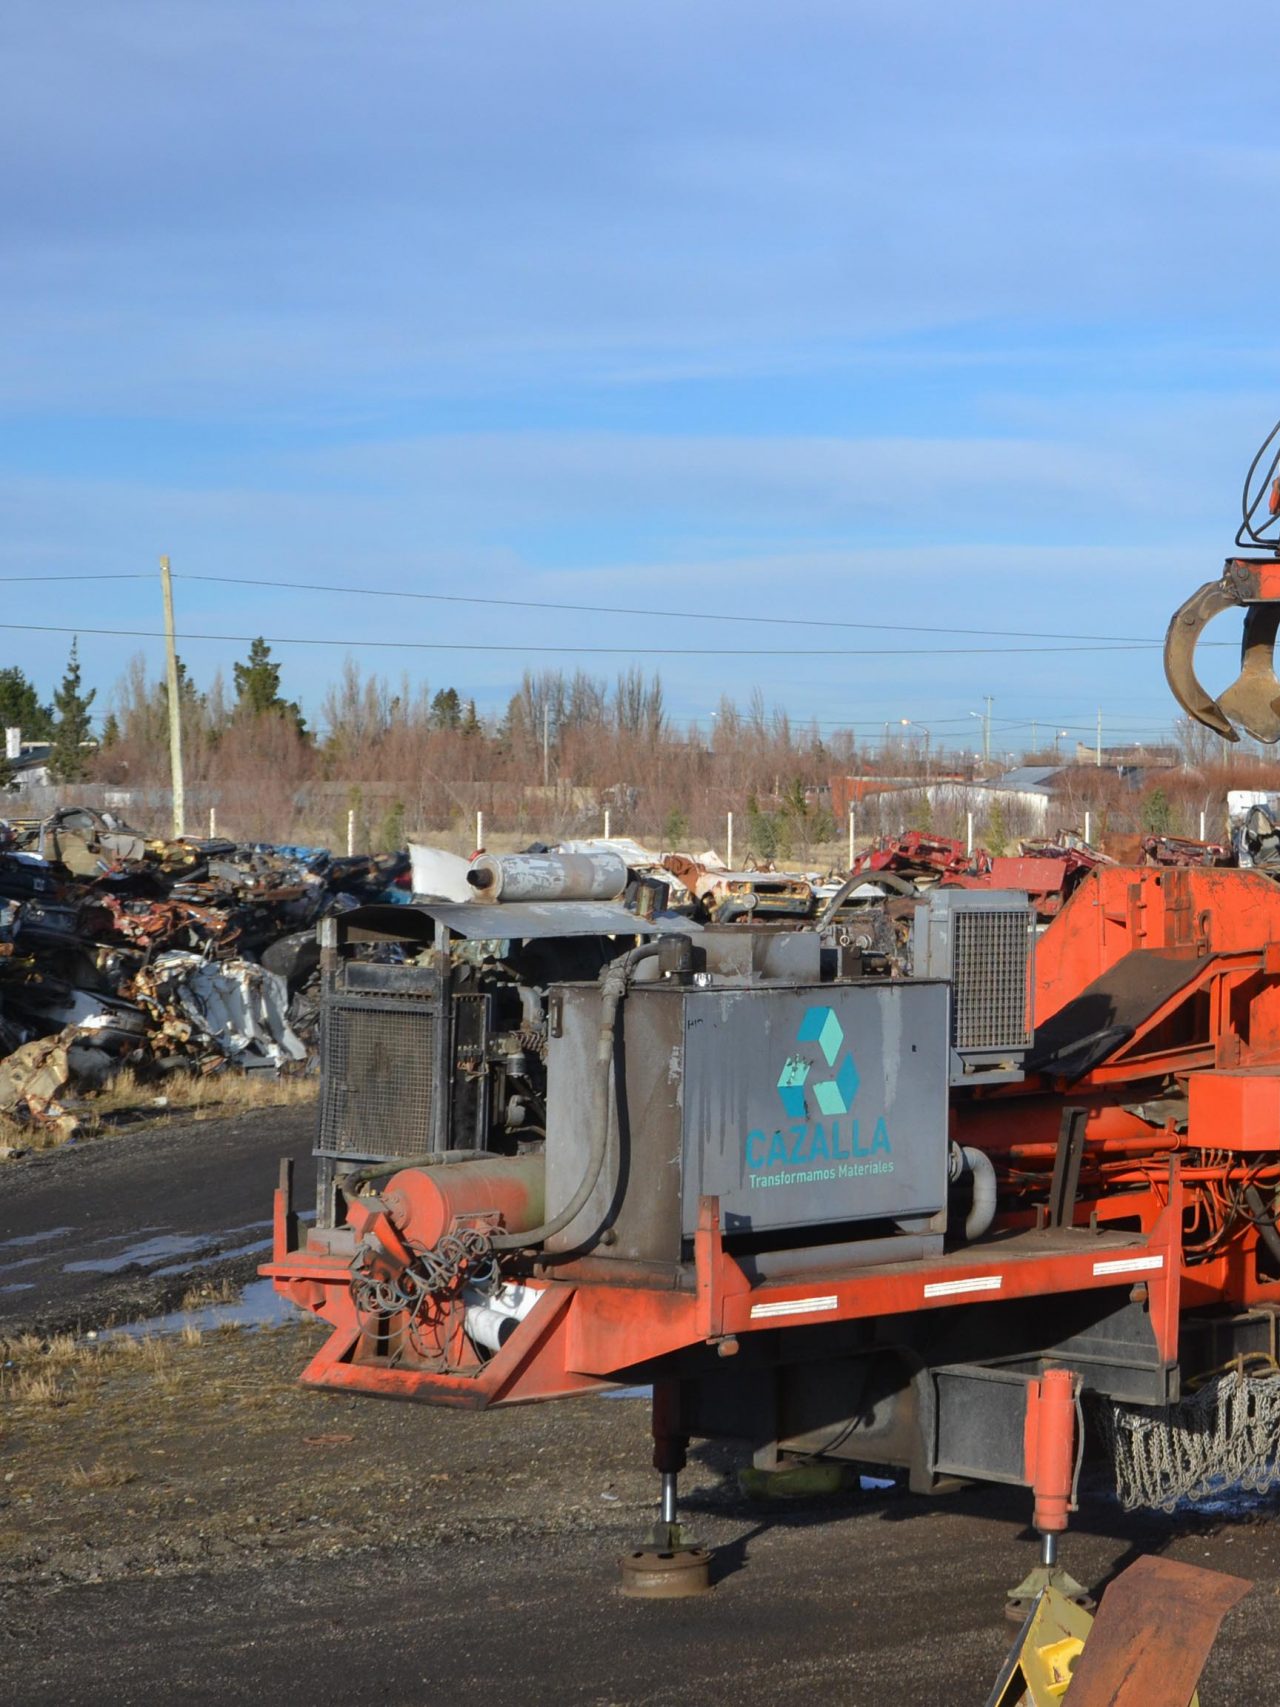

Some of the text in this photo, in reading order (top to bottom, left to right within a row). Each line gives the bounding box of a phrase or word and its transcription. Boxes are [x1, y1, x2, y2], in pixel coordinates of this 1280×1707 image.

[746, 1116, 892, 1169] CAZALLA
[749, 1161, 895, 1189] Transformamos Materiales
